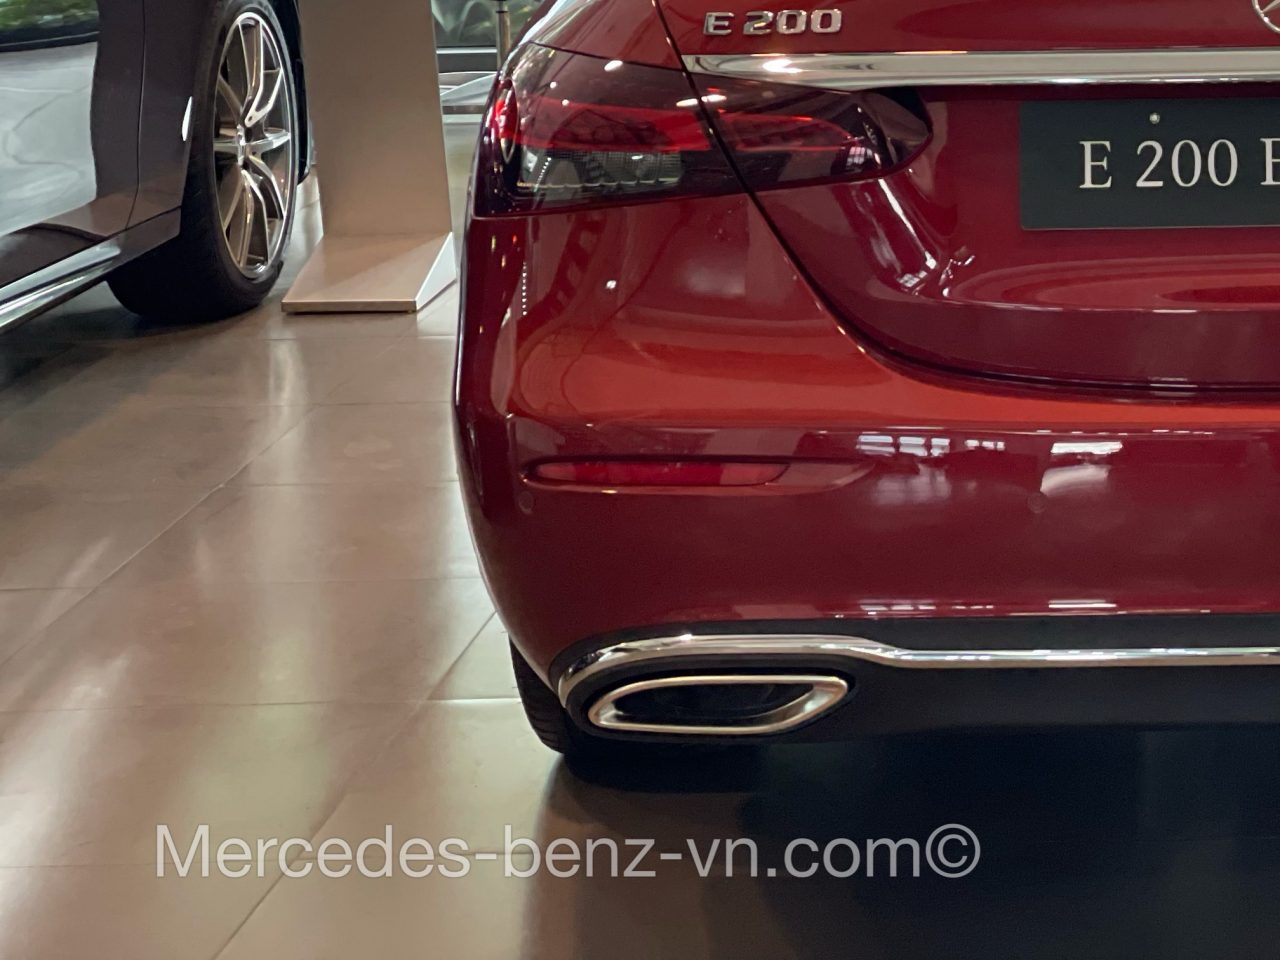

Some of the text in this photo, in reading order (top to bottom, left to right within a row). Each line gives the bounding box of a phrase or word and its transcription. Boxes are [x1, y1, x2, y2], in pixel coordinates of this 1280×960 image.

[703, 8, 843, 36] E 200
[1079, 140, 1112, 188] E
[1135, 139, 1238, 188] 200
